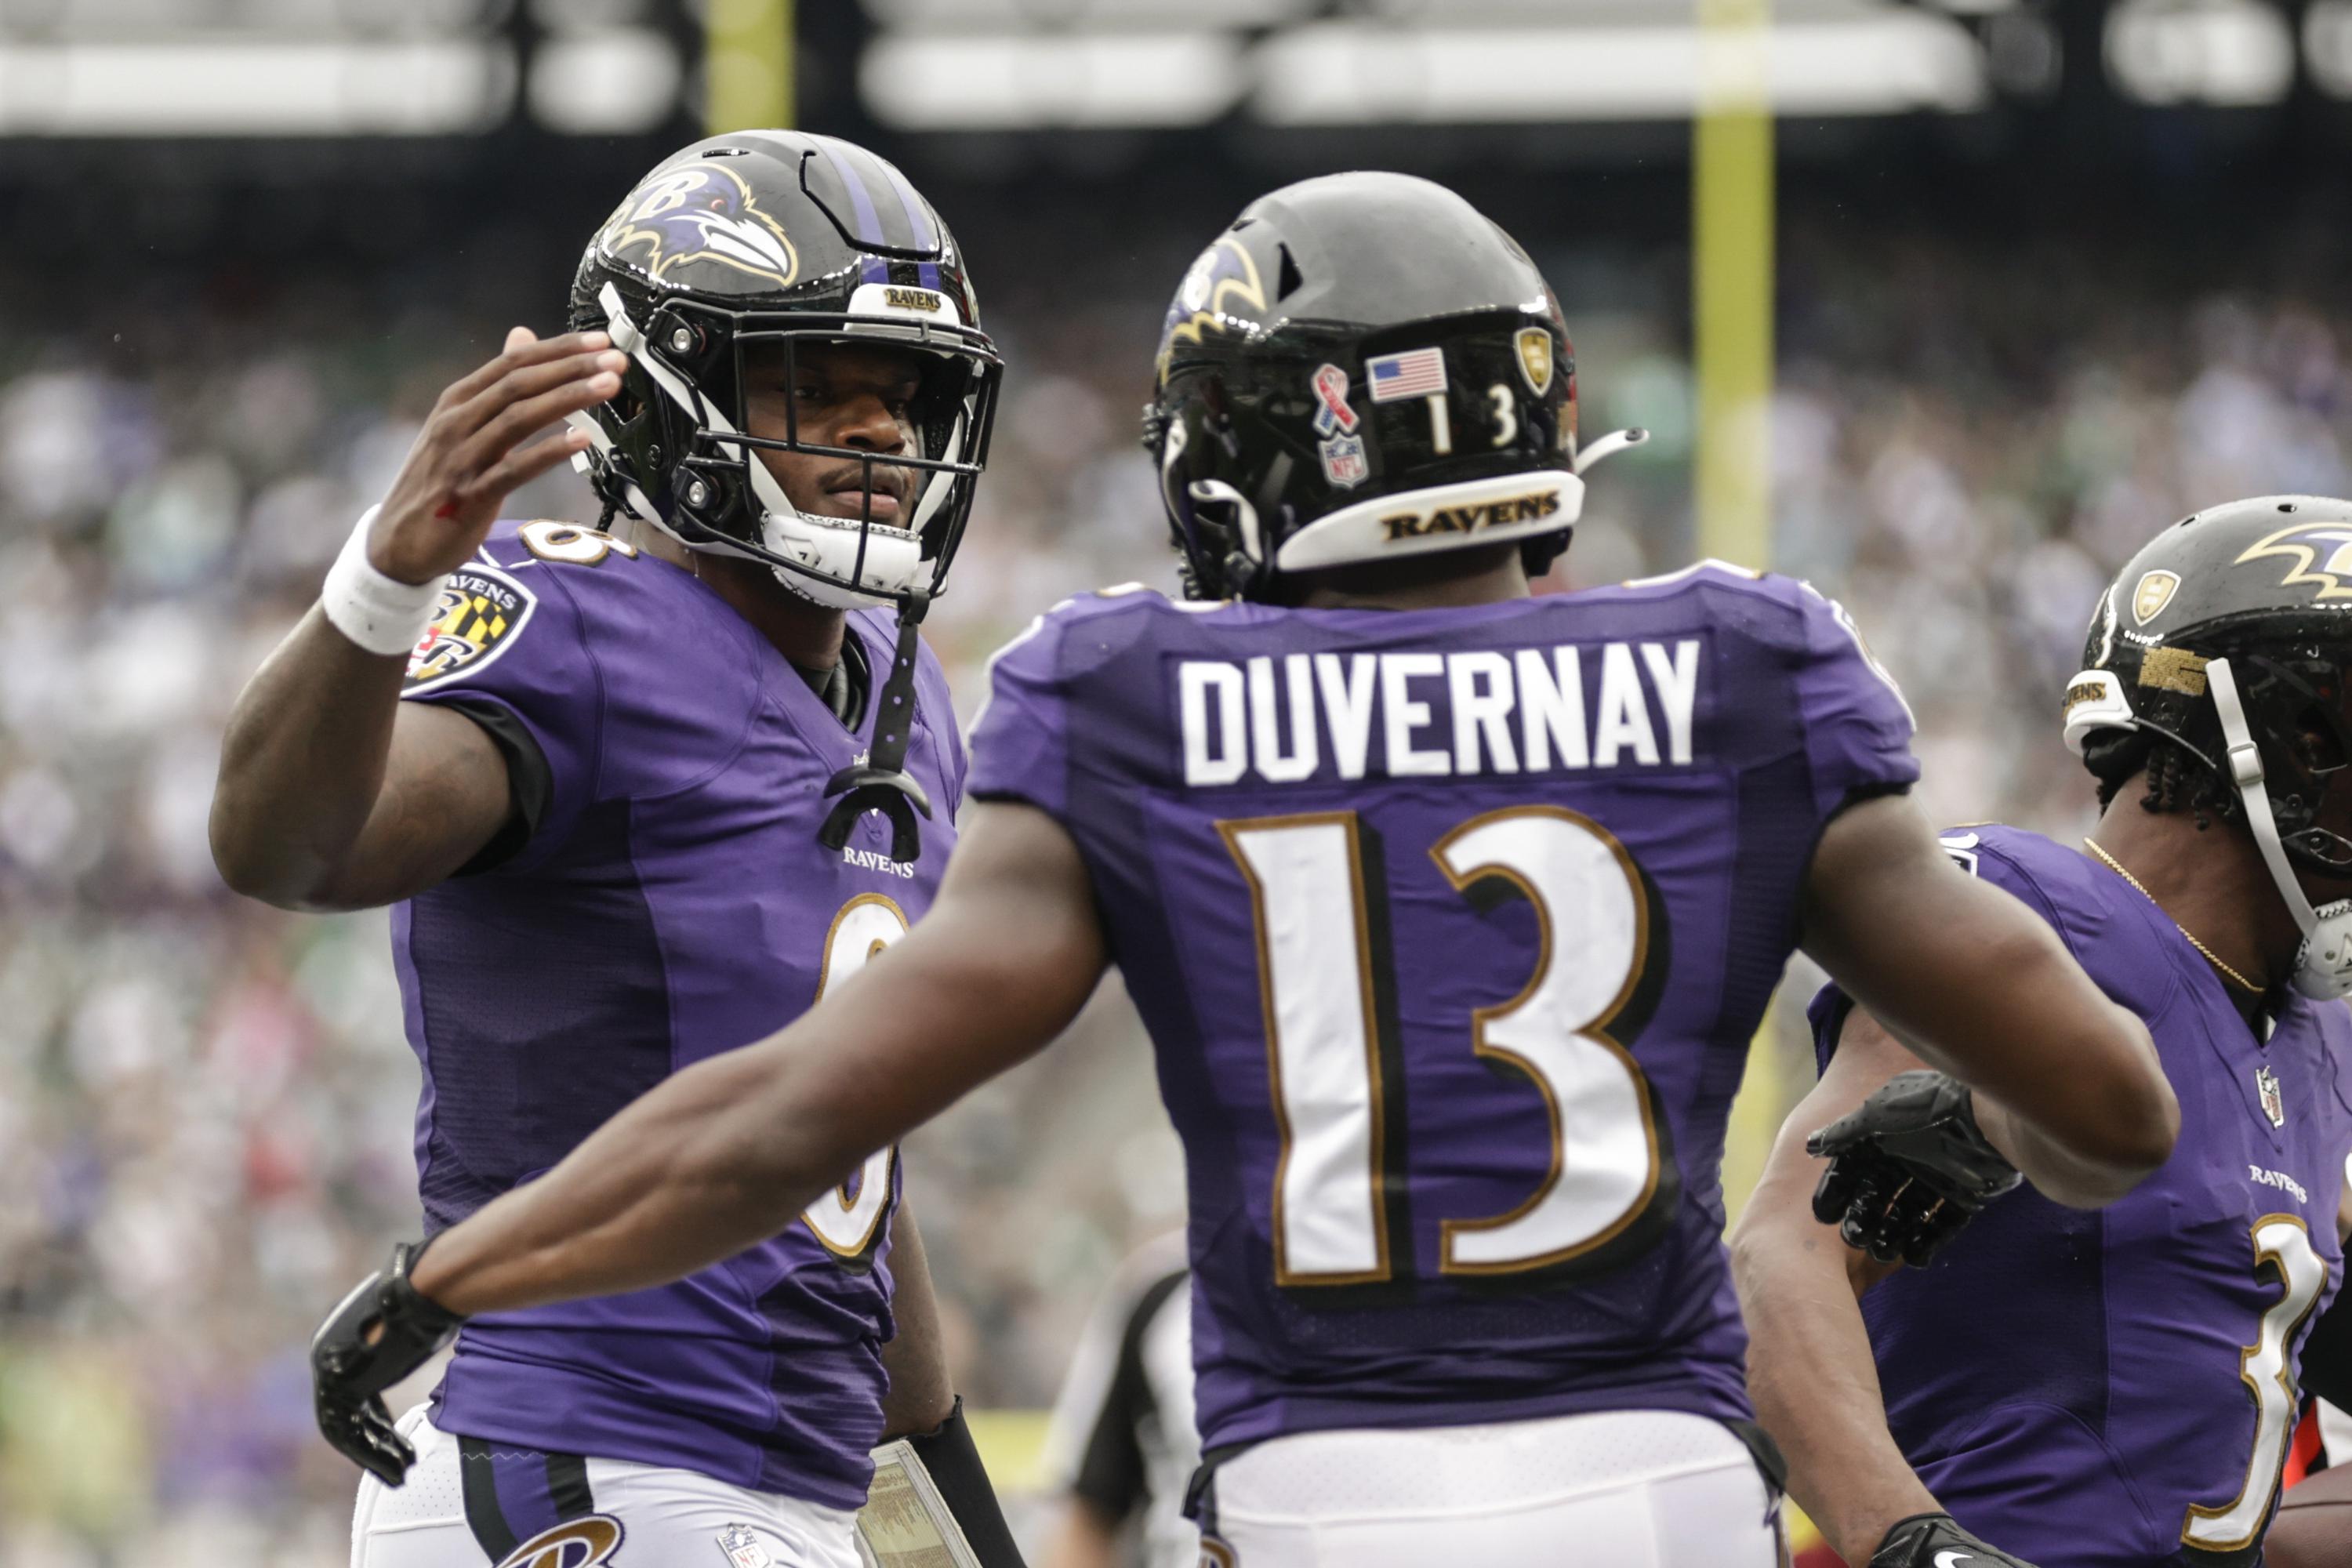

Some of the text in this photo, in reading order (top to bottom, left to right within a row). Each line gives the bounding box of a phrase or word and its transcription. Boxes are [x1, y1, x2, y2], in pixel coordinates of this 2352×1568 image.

[884, 288, 942, 312] RAVENS
[1380, 489, 1561, 543] RAVENS
[448, 575, 517, 610] AVENS
[1179, 640, 1700, 786] DUVERNAY
[843, 847, 914, 879] RAVENS
[1214, 804, 1662, 1287] 13
[2248, 1165, 2307, 1203] RAVENS
[2180, 1213, 2328, 1552] 3
